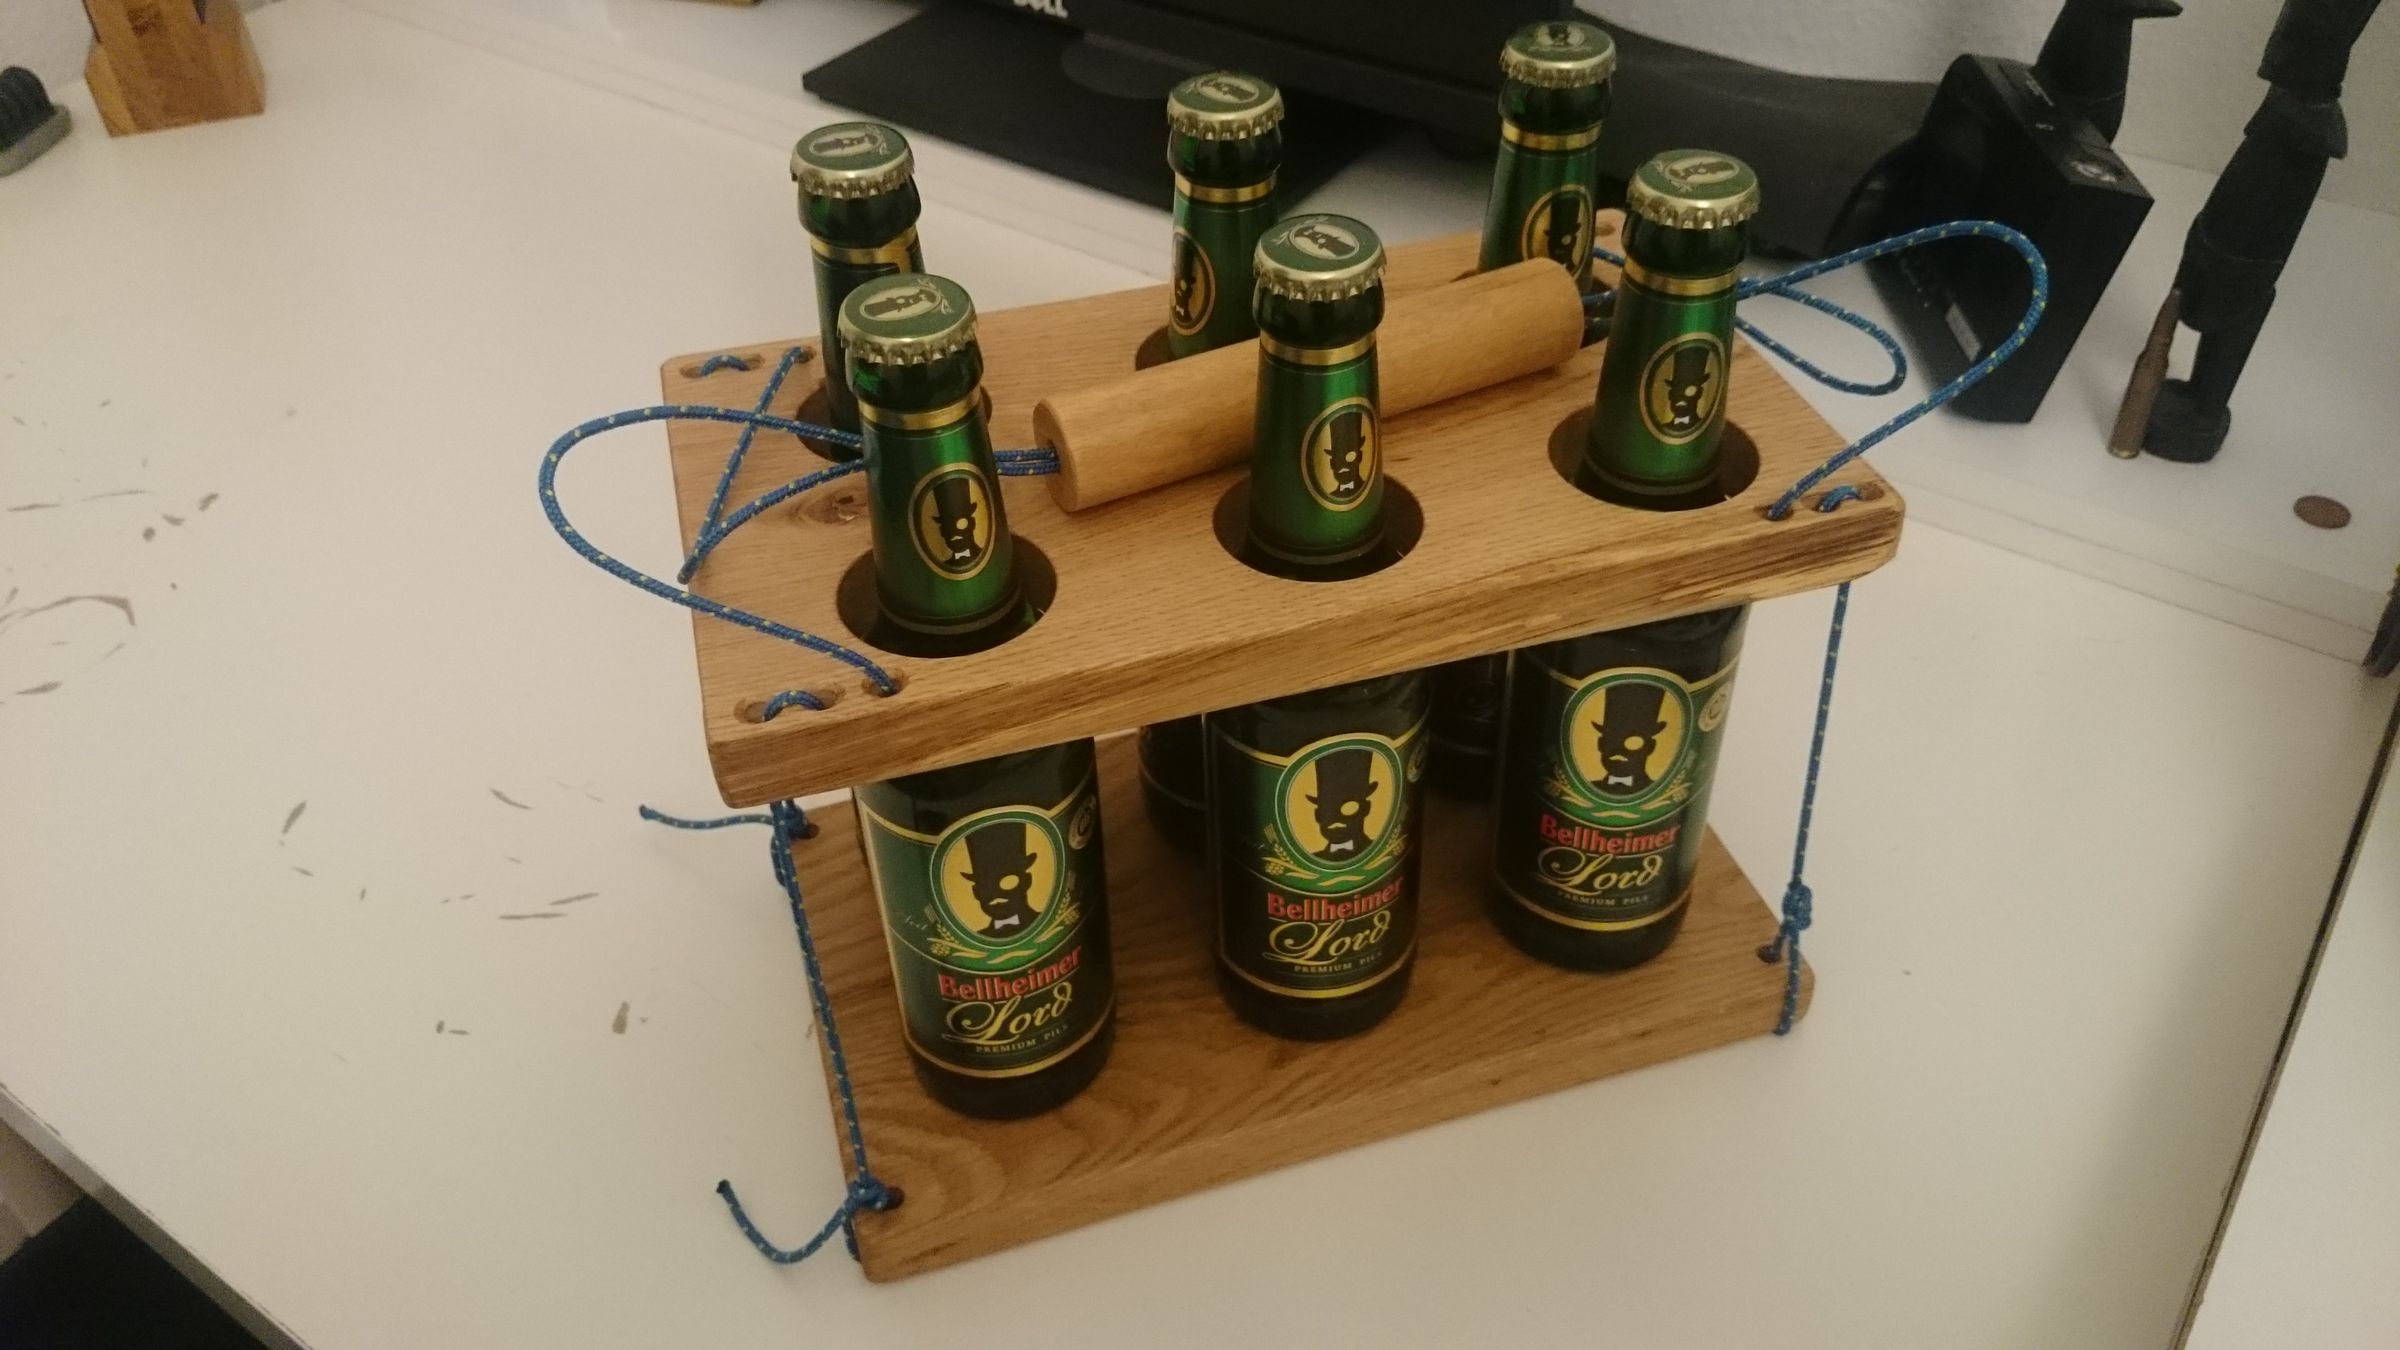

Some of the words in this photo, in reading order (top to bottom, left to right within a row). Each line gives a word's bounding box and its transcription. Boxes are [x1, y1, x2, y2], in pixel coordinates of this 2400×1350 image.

[1540, 814, 1681, 854] Bellheimer
[1536, 846, 1663, 896] Lord
[1267, 876, 1404, 921] Bellheimer
[1262, 910, 1391, 965] Lord
[938, 945, 1081, 1000] Bellheimer
[1294, 962, 1352, 973] PREMIUM
[941, 981, 1072, 1046] Lord
[976, 1039, 1037, 1053] PREMIUM
